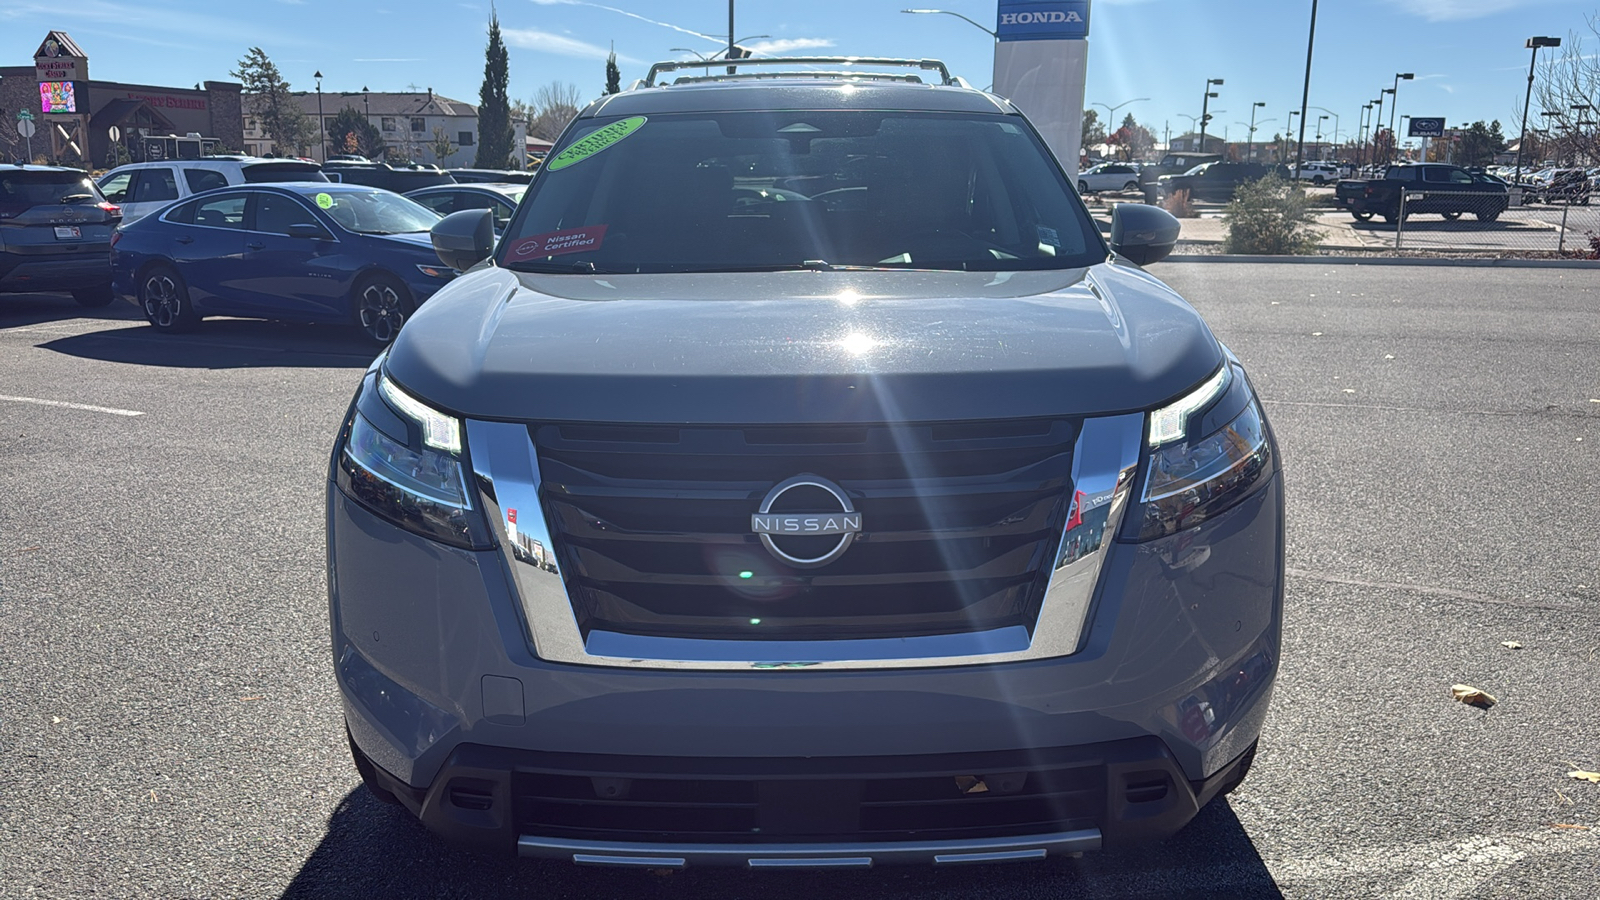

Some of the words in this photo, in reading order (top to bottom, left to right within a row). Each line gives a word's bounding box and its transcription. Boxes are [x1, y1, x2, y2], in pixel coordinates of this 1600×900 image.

[1001, 11, 1082, 25] HONDA
[558, 121, 627, 160] CERTIFIED
[544, 238, 595, 251] Certified
[547, 233, 586, 244] Nissan
[755, 516, 859, 531] NISSAN
